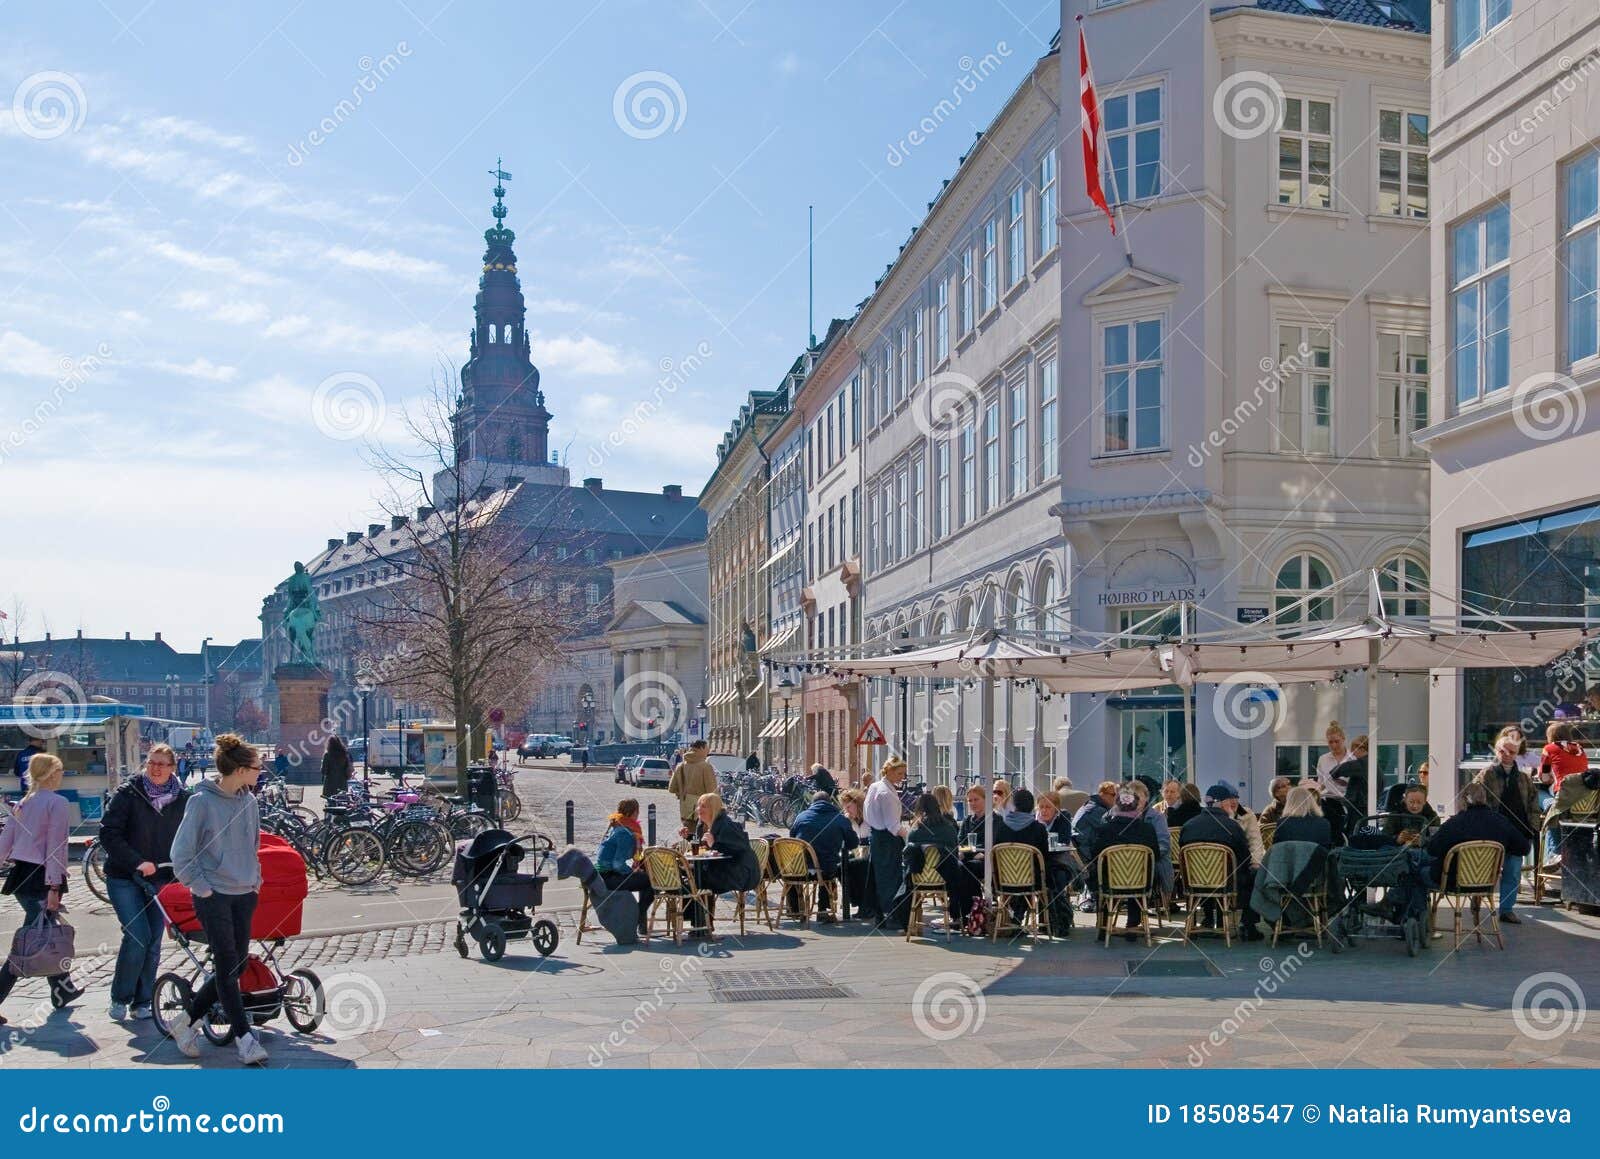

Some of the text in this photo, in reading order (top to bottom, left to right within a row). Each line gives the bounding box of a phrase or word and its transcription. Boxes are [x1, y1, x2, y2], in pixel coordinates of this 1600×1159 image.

[1098, 588, 1206, 605] HØJBRO PLADS 4
[690, 719, 697, 728] P
